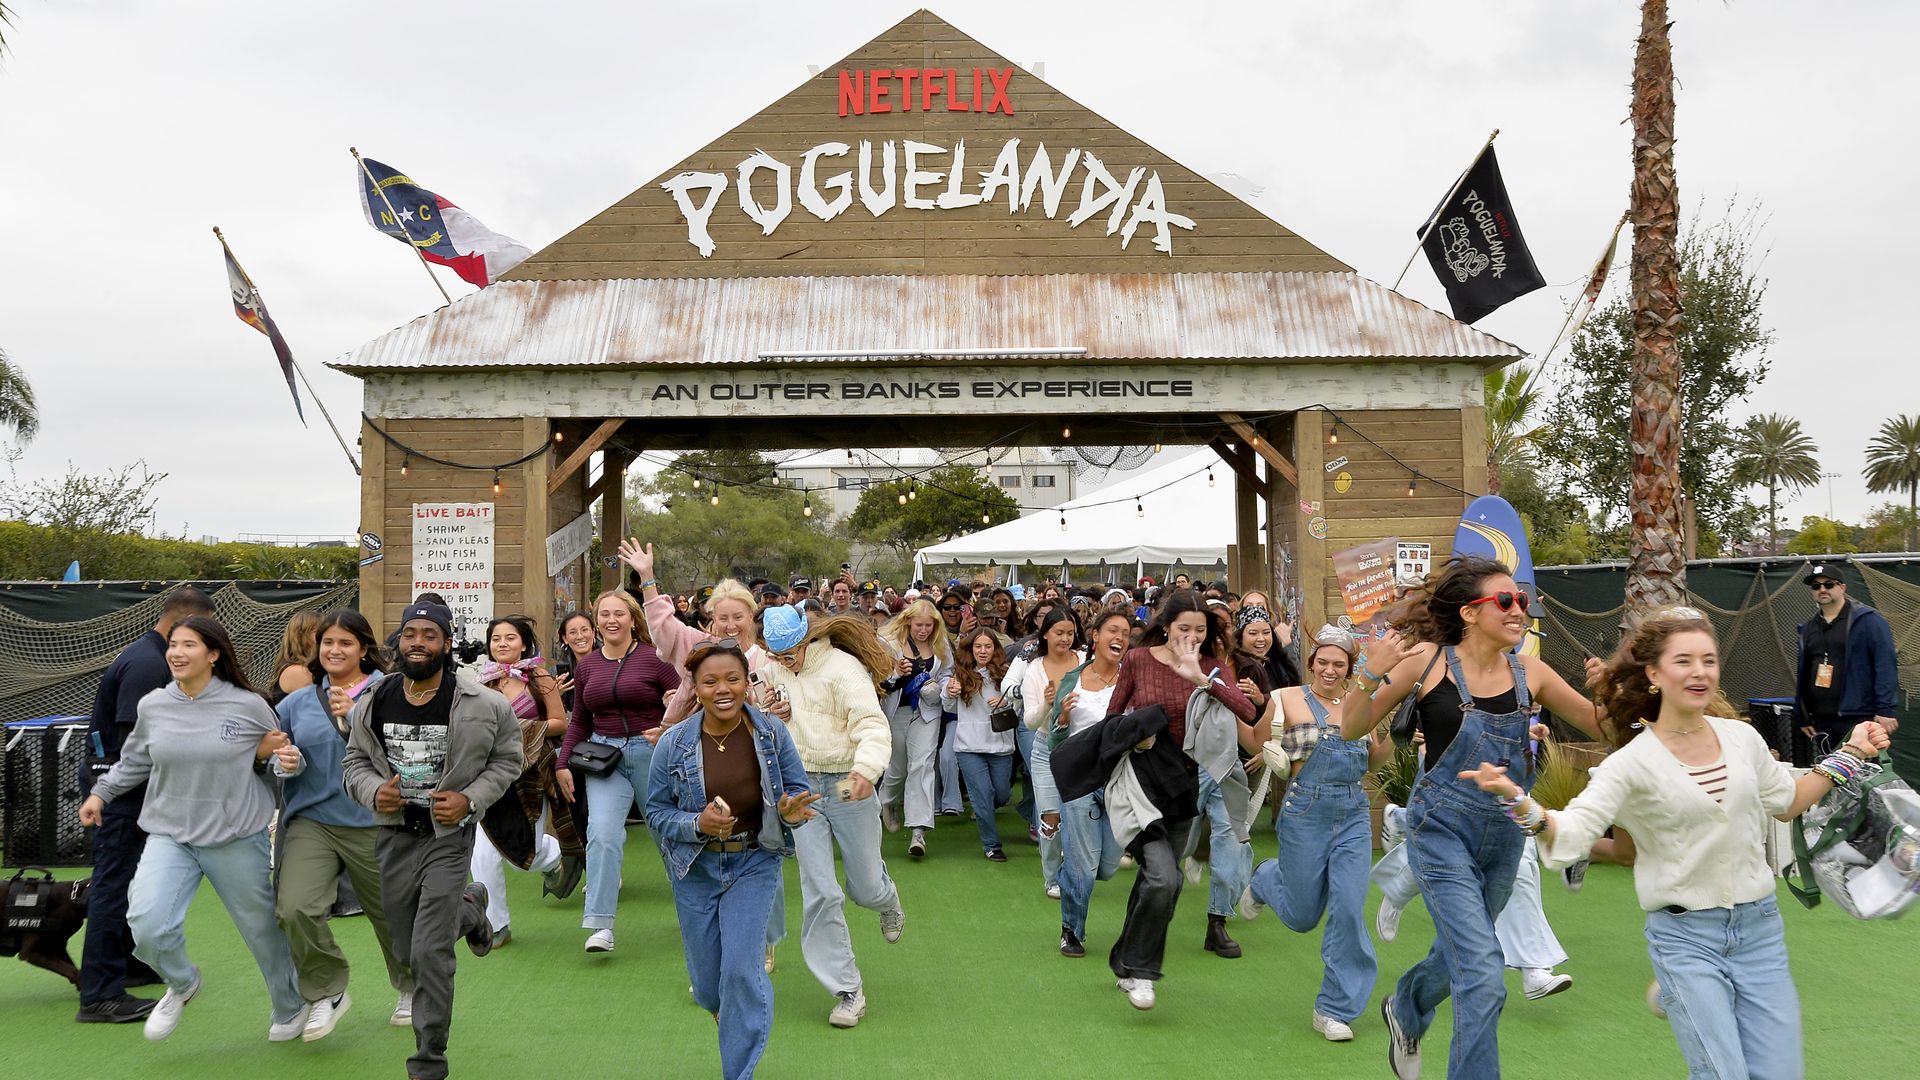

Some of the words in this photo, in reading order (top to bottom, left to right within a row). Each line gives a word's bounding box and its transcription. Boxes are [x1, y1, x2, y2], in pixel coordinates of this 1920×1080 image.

[838, 67, 1015, 117] NETFLIX
[659, 136, 1198, 258] POGUELANDIA
[380, 210, 395, 225] N
[419, 204, 431, 221] C
[1462, 189, 1507, 279] POGUELANDIA
[651, 384, 699, 400] AN
[710, 383, 830, 400] OUTER
[841, 382, 960, 399] BANKS
[972, 380, 1193, 398] EXPERIENCE
[416, 508, 449, 518] LIVE
[456, 507, 490, 518] BAIT
[427, 525, 466, 534] SHRIMP
[362, 534, 381, 549] OBX
[426, 537, 455, 546] SAND
[459, 536, 489, 545] FLEAS
[428, 550, 447, 559] PIN
[453, 549, 477, 558] FISH
[427, 563, 452, 573] BLUE
[457, 562, 485, 572] CRAB
[415, 581, 460, 590] FROZEN
[464, 582, 490, 590] BAIT
[459, 594, 479, 603] BITS
[455, 617, 489, 625] BOCKS
